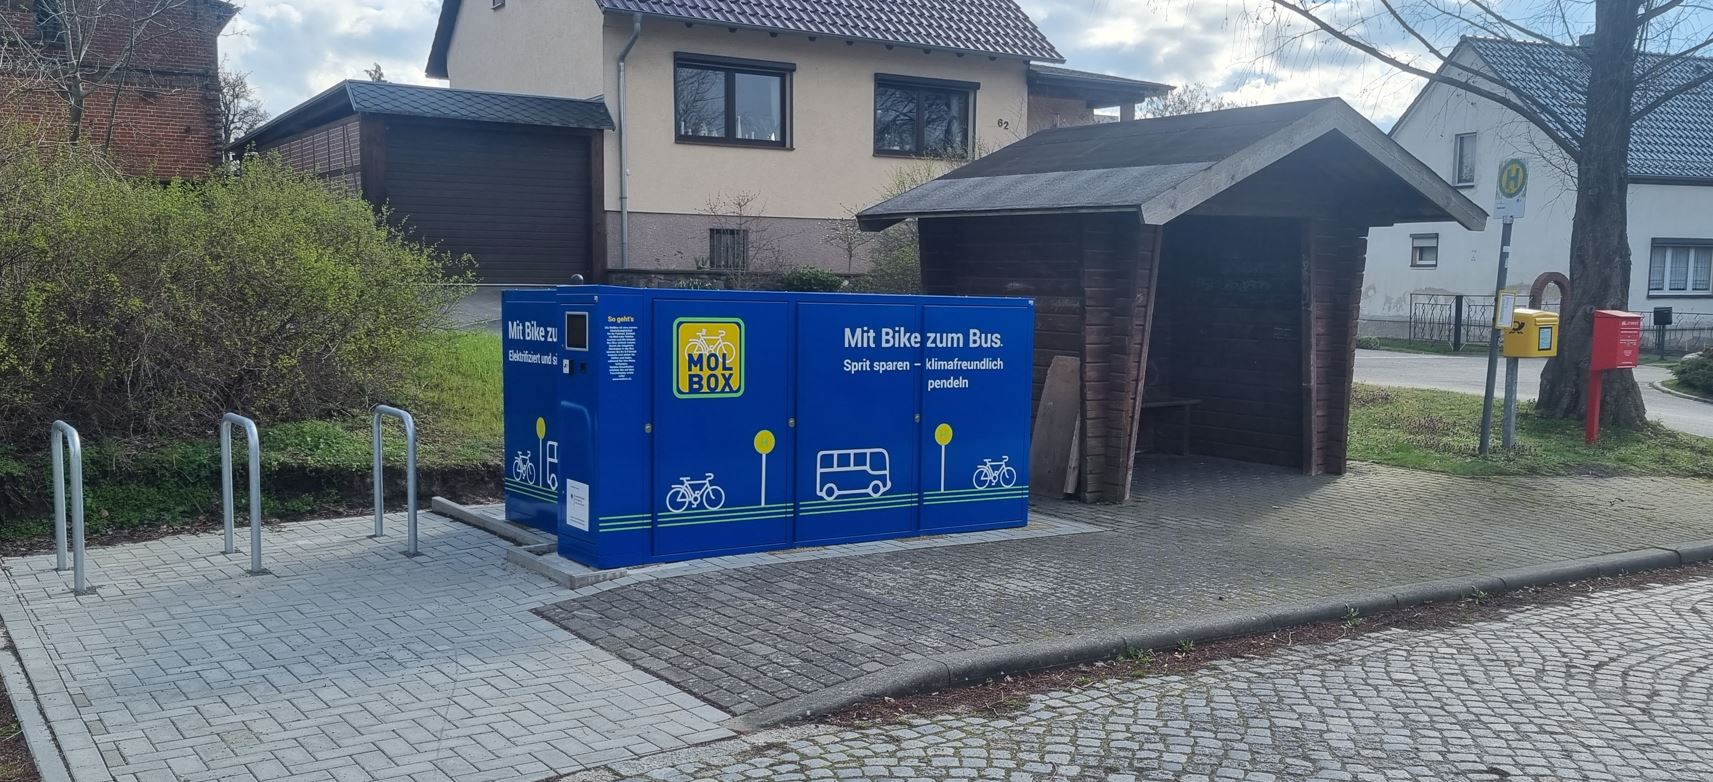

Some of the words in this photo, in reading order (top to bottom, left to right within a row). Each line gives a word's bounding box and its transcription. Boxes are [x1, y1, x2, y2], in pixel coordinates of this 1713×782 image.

[997, 118, 1009, 130] 62
[1505, 167, 1521, 189] H
[508, 320, 523, 340] Mit
[525, 320, 545, 342] Bike
[844, 326, 876, 348] Mit
[881, 326, 921, 348] Bike
[926, 332, 964, 348] zum
[969, 328, 1004, 348] Bus.
[508, 349, 541, 363] Elektrifiziert
[541, 352, 552, 365] und
[687, 352, 734, 372] MOL
[843, 358, 871, 374] Sprit
[873, 361, 910, 374] sparen
[925, 357, 1004, 370] klimafreundlich
[687, 373, 735, 393] BOX
[927, 376, 969, 392] pendeln
